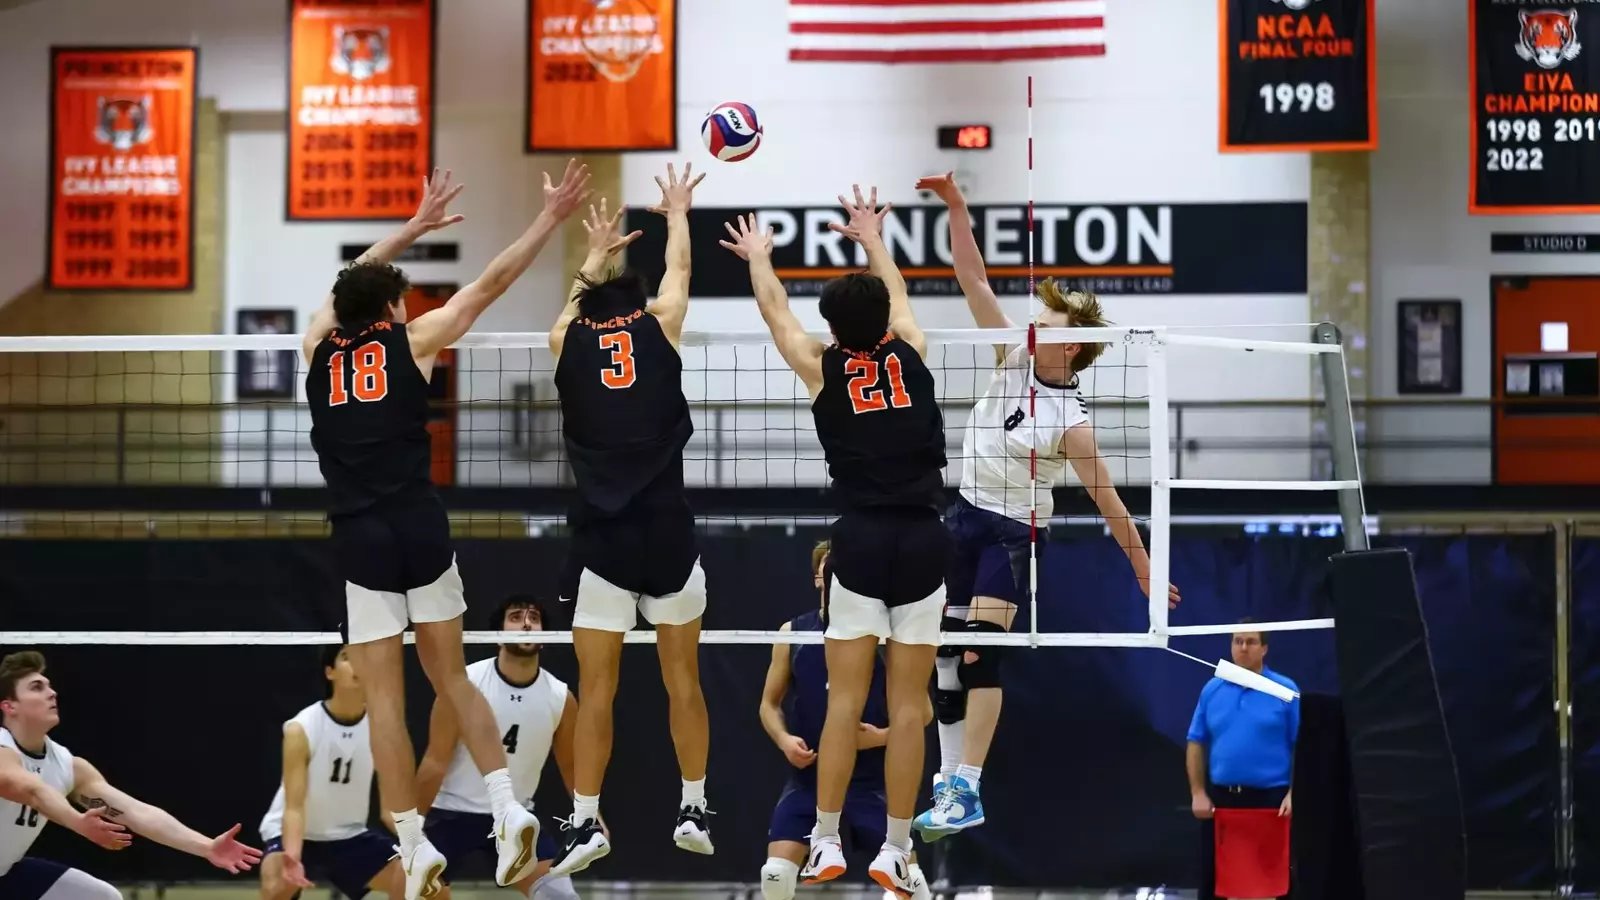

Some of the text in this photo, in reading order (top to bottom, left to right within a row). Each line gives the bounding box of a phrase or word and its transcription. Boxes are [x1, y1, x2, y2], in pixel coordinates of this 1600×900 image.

[1257, 13, 1336, 39] NCAA
[1239, 38, 1354, 59] FINAL FOUR
[1524, 72, 1574, 92] EIVA
[1259, 82, 1336, 113] 1998
[1486, 117, 1600, 142] 1998 201
[1486, 147, 1544, 171] 2022
[1523, 235, 1587, 251] STUDIO D
[577, 309, 646, 330] RINCETO
[599, 330, 636, 389] 3
[327, 340, 388, 407] 18
[844, 352, 912, 414] 21
[1003, 407, 1025, 432] 8
[502, 724, 520, 754] 4
[330, 757, 353, 784] 11
